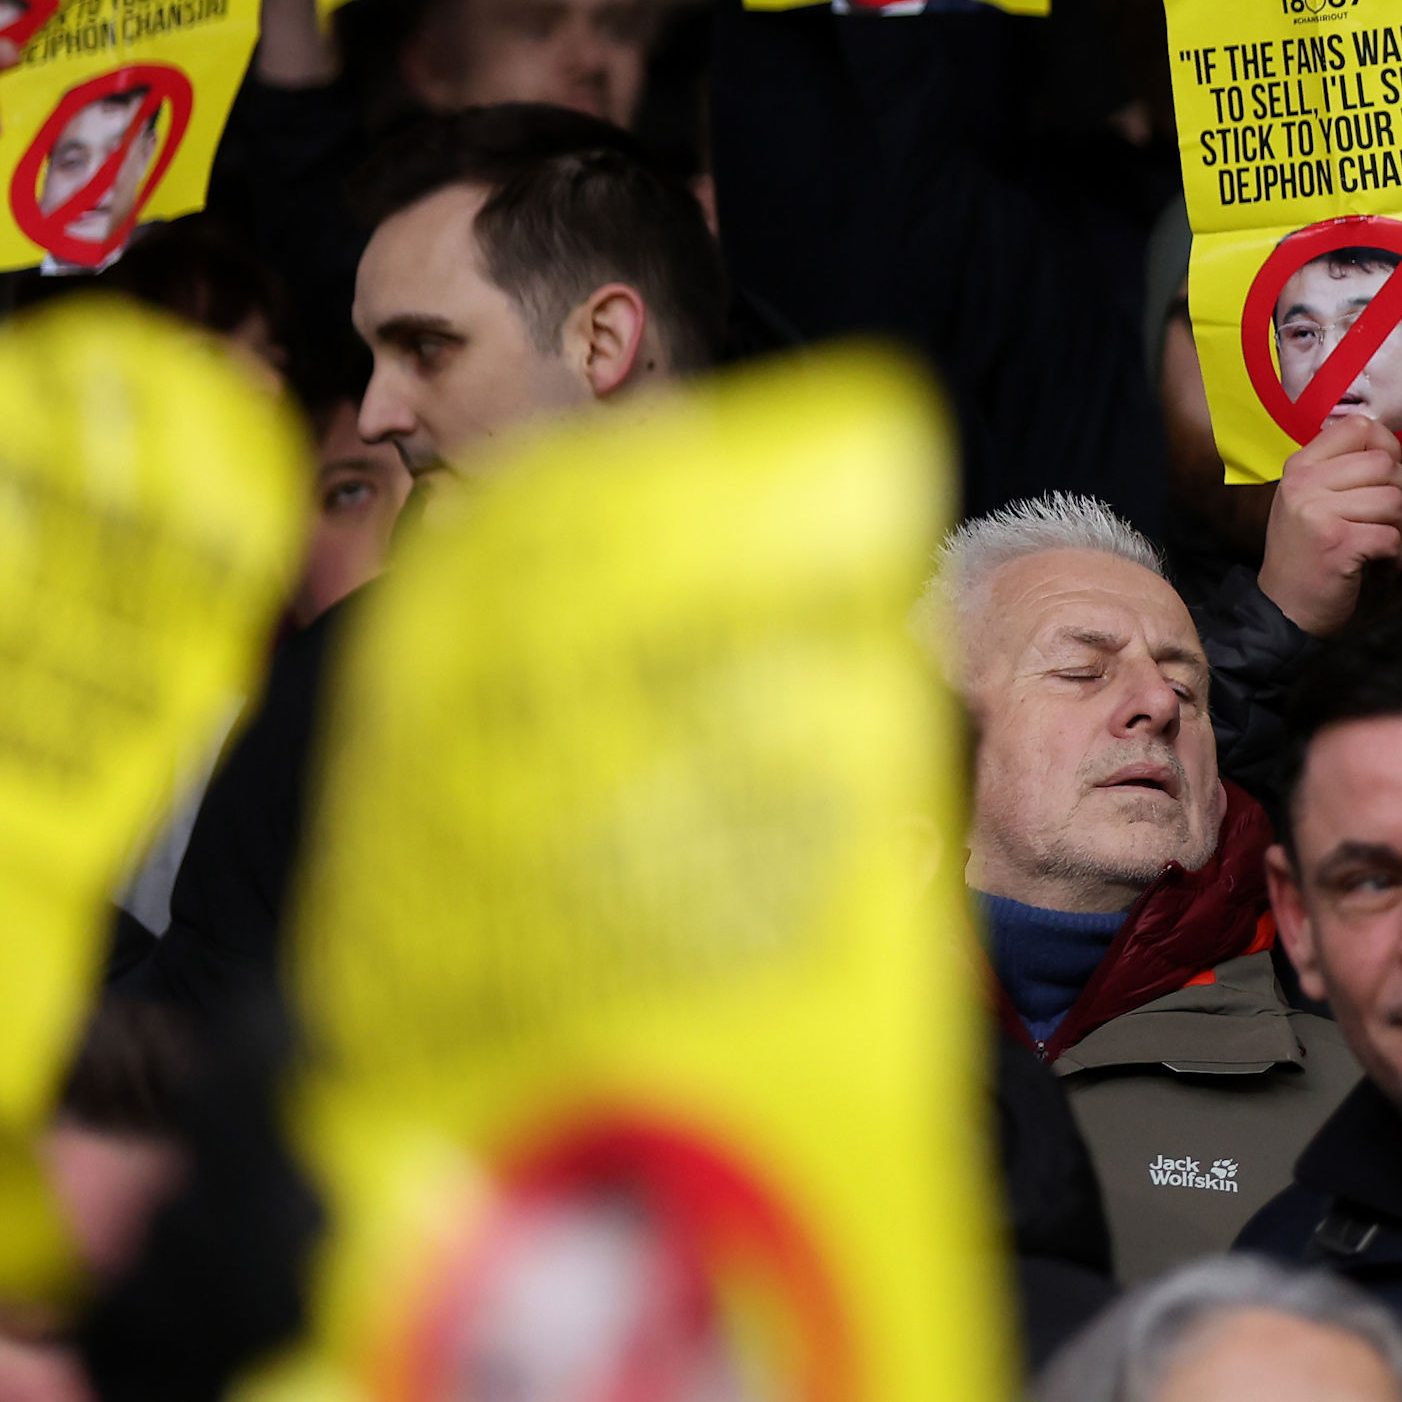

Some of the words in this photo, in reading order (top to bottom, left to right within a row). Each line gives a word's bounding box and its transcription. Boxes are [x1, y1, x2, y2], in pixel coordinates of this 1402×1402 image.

[1223, 42, 1276, 81] THE
[1282, 34, 1345, 76] FANS
[1210, 86, 1244, 123] TO
[1251, 79, 1318, 119] SELL,
[1322, 72, 1374, 113] I'LL
[1200, 125, 1275, 166] STICK
[1281, 120, 1314, 154] TO
[1318, 111, 1395, 153] YOUR
[1219, 159, 1333, 205] DEJPHON
[1150, 1155, 1200, 1172] Jack
[1150, 1170, 1238, 1192] Wolfskin
